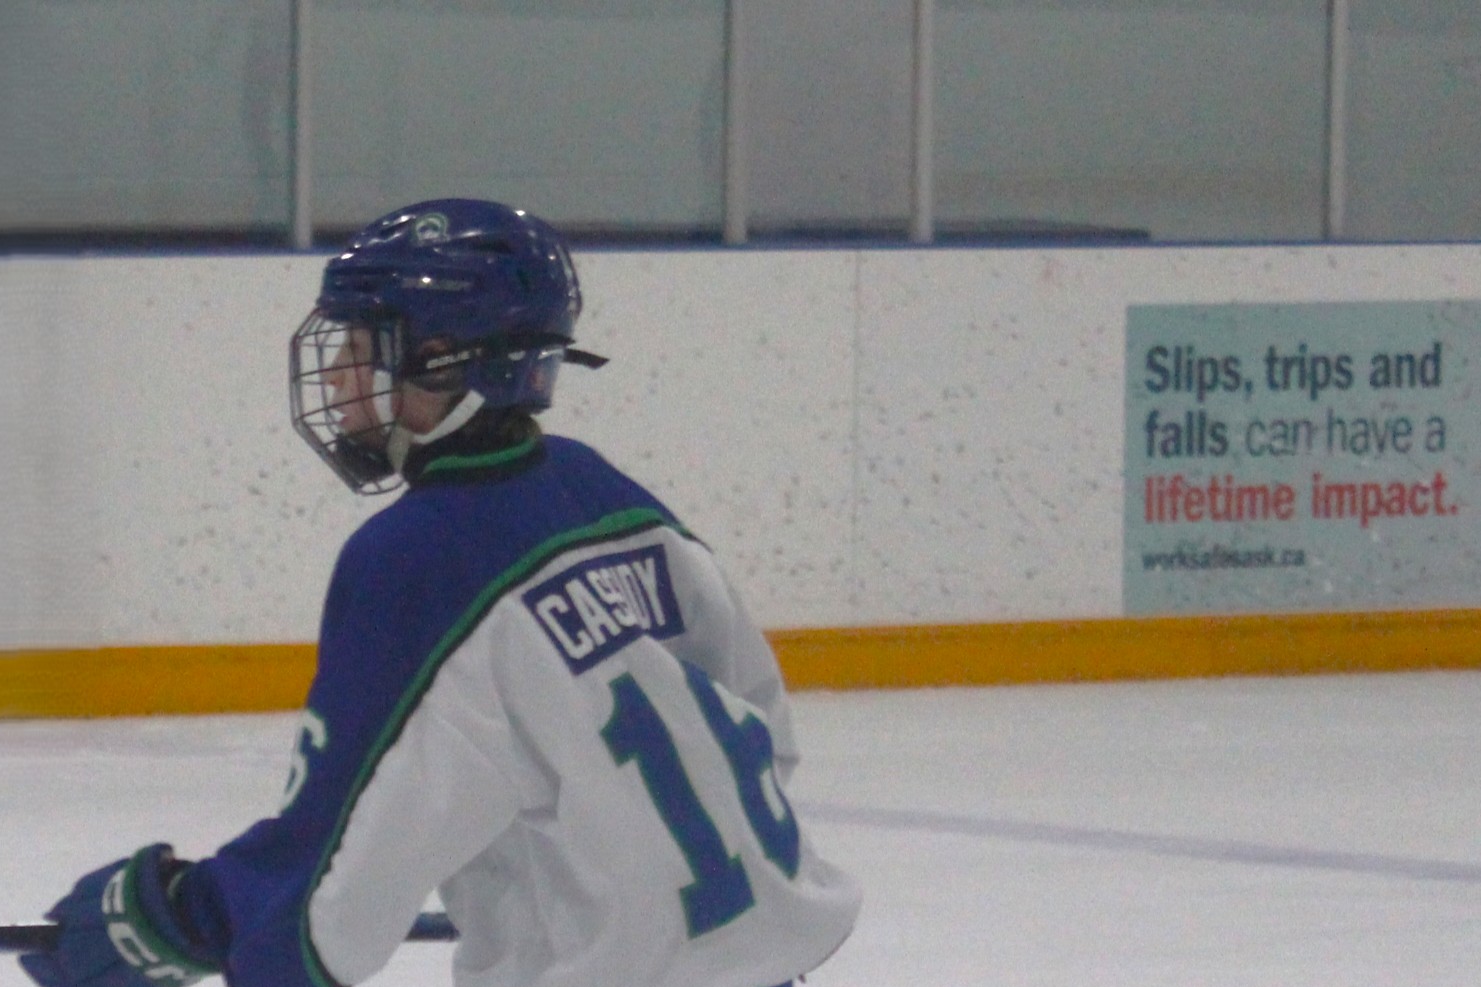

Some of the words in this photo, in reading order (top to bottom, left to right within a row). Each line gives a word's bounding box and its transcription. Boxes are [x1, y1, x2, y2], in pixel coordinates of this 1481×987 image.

[1143, 344, 1254, 402] Slips,
[1264, 343, 1354, 402] trips
[1368, 341, 1443, 391] and
[1143, 408, 1230, 459] falls
[1244, 417, 1315, 458] can
[1325, 407, 1413, 456] have
[1424, 414, 1447, 454] a
[1143, 472, 1297, 524] lifetime
[1310, 469, 1460, 529] impact.
[600, 660, 801, 940] 16
